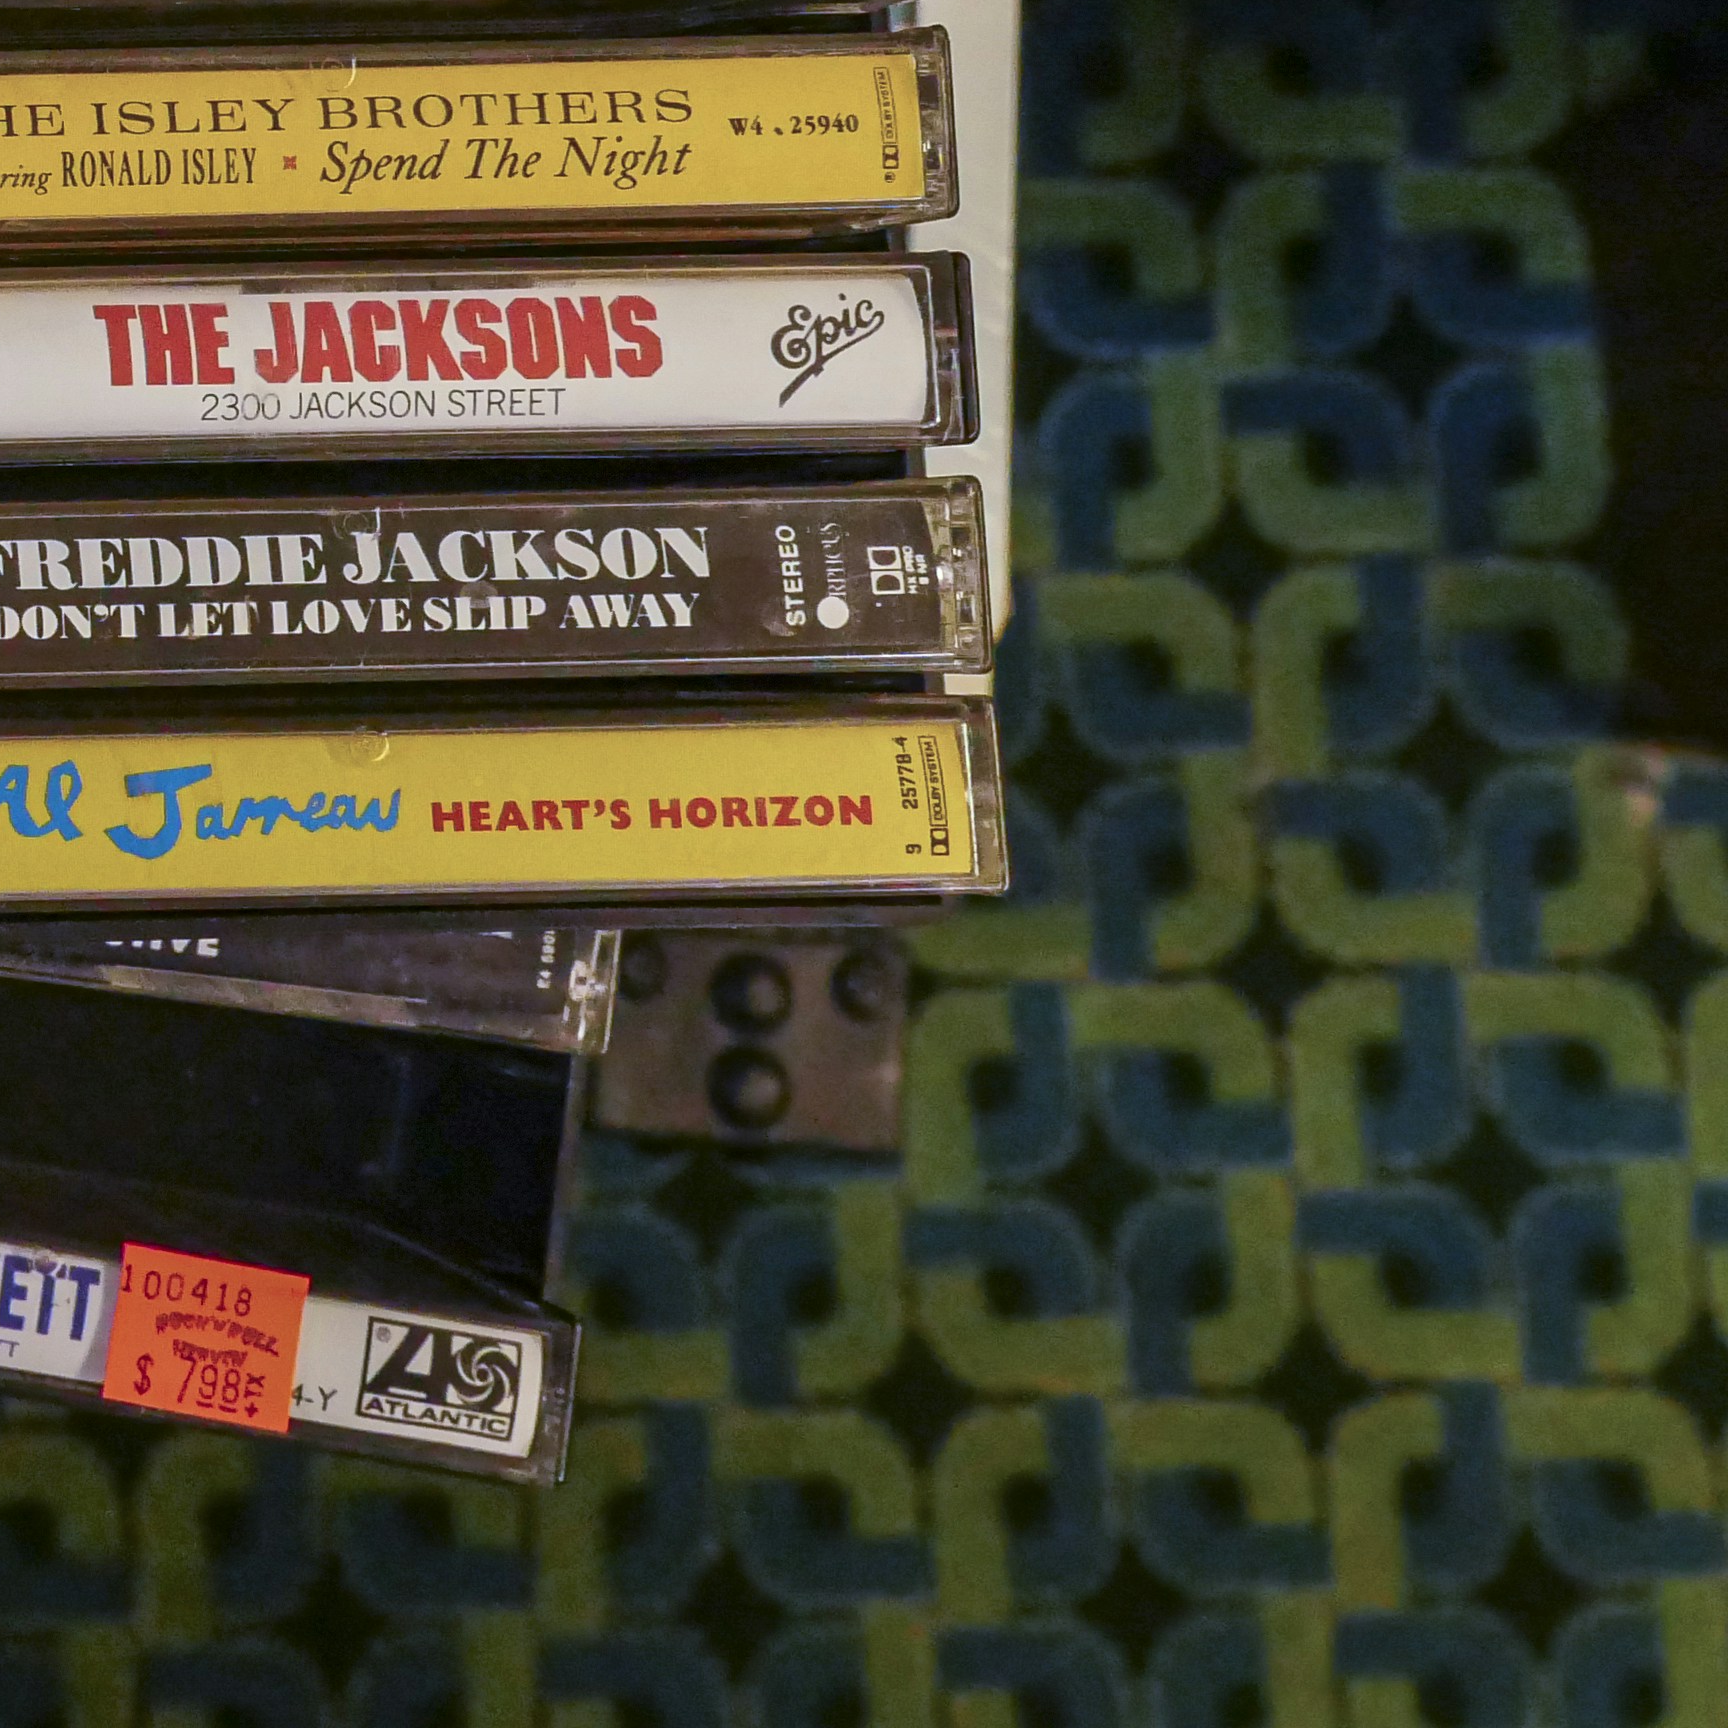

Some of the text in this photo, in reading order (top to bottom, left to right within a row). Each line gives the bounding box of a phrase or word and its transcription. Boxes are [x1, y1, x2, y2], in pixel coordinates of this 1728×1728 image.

[91, 97, 297, 136] ISLEY
[317, 88, 694, 132] BROTHERS
[320, 134, 693, 196] Spend The Night
[91, 294, 665, 388] THE JACKSONS
[200, 387, 568, 422] 2300 JACKSON STREET
[343, 525, 713, 586] JACKSON
[774, 524, 809, 629] STEREO
[430, 794, 874, 833] HEART'S HORIZON
